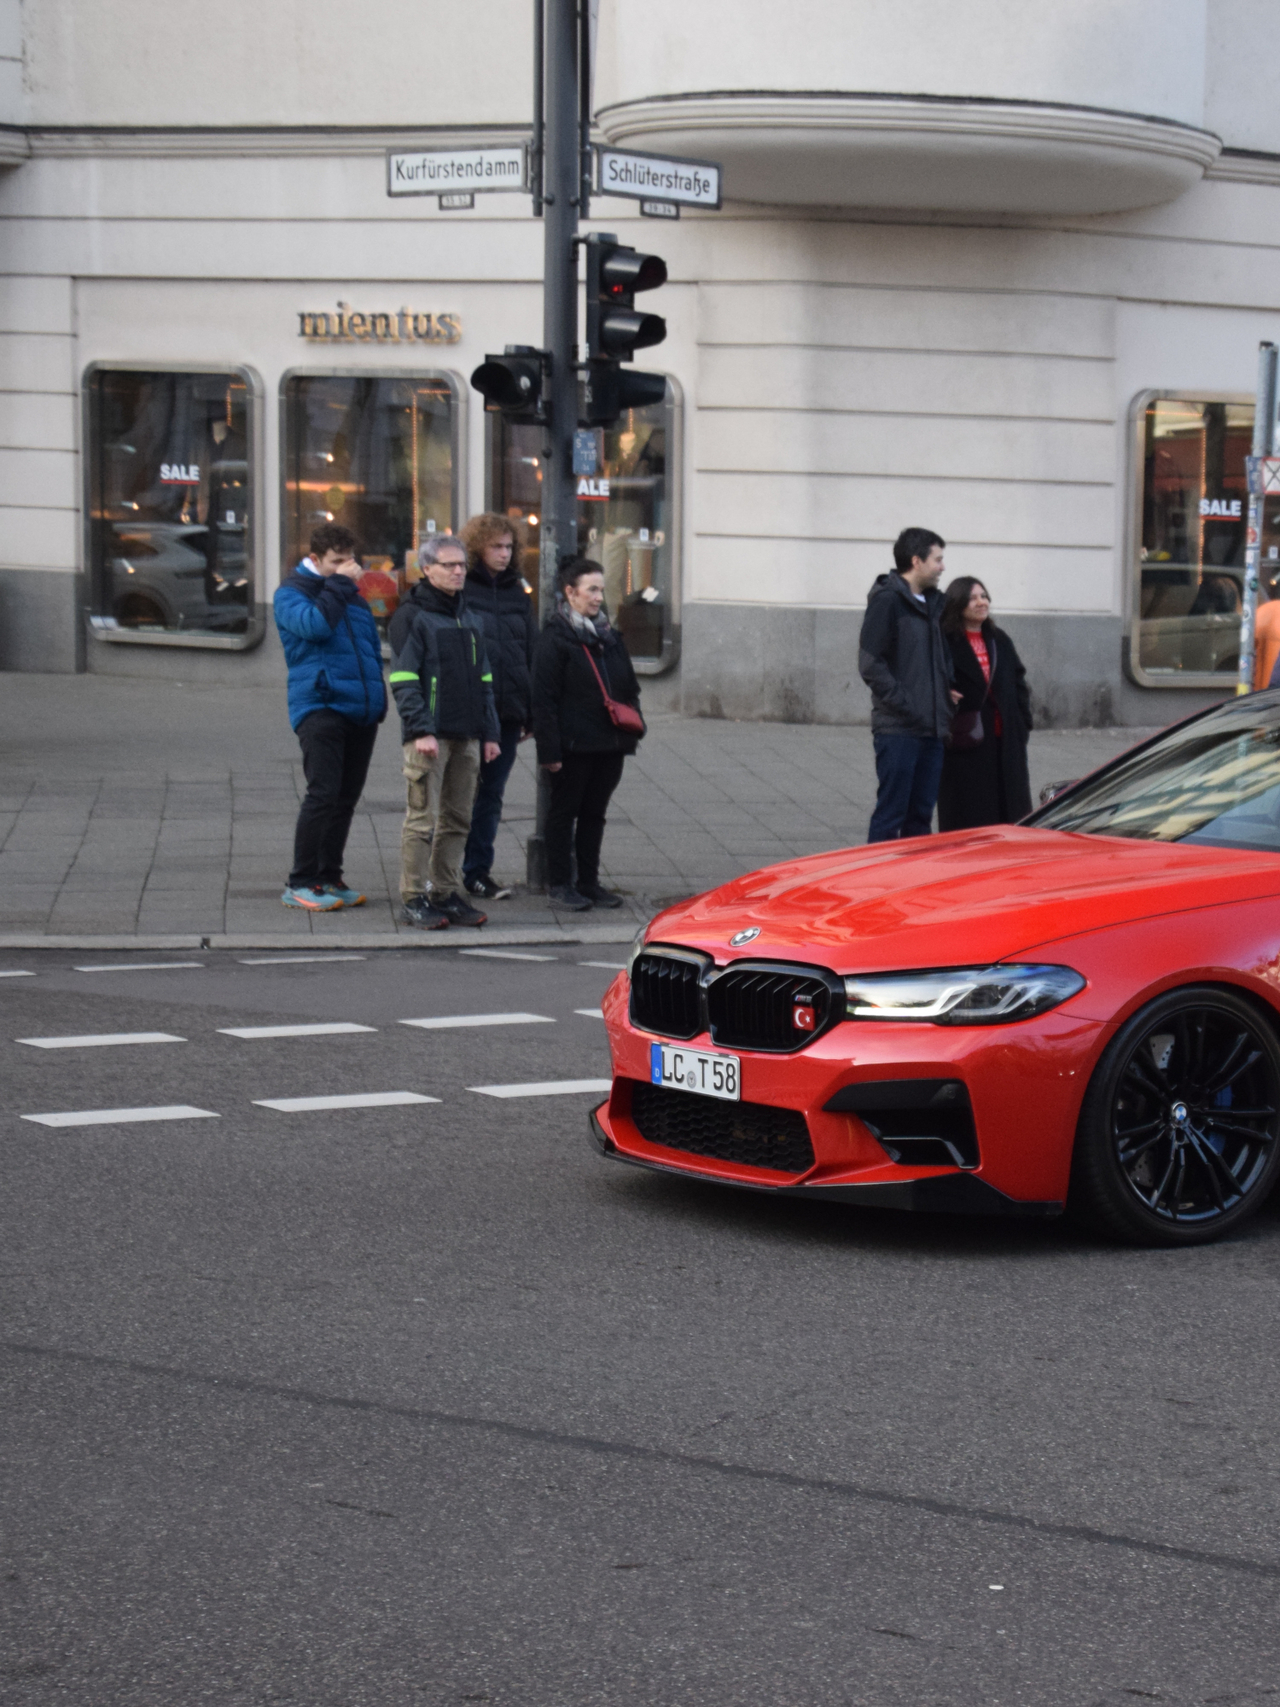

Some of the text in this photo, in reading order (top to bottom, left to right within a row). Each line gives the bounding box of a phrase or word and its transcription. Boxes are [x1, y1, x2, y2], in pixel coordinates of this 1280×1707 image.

[395, 156, 520, 181] Kurfürstendamm
[608, 159, 711, 197] Schlüterstraße
[298, 301, 461, 344] mientus
[160, 464, 200, 480] SALE
[577, 479, 610, 496] ALE
[1199, 499, 1241, 516] SALE
[661, 1051, 685, 1084] LC
